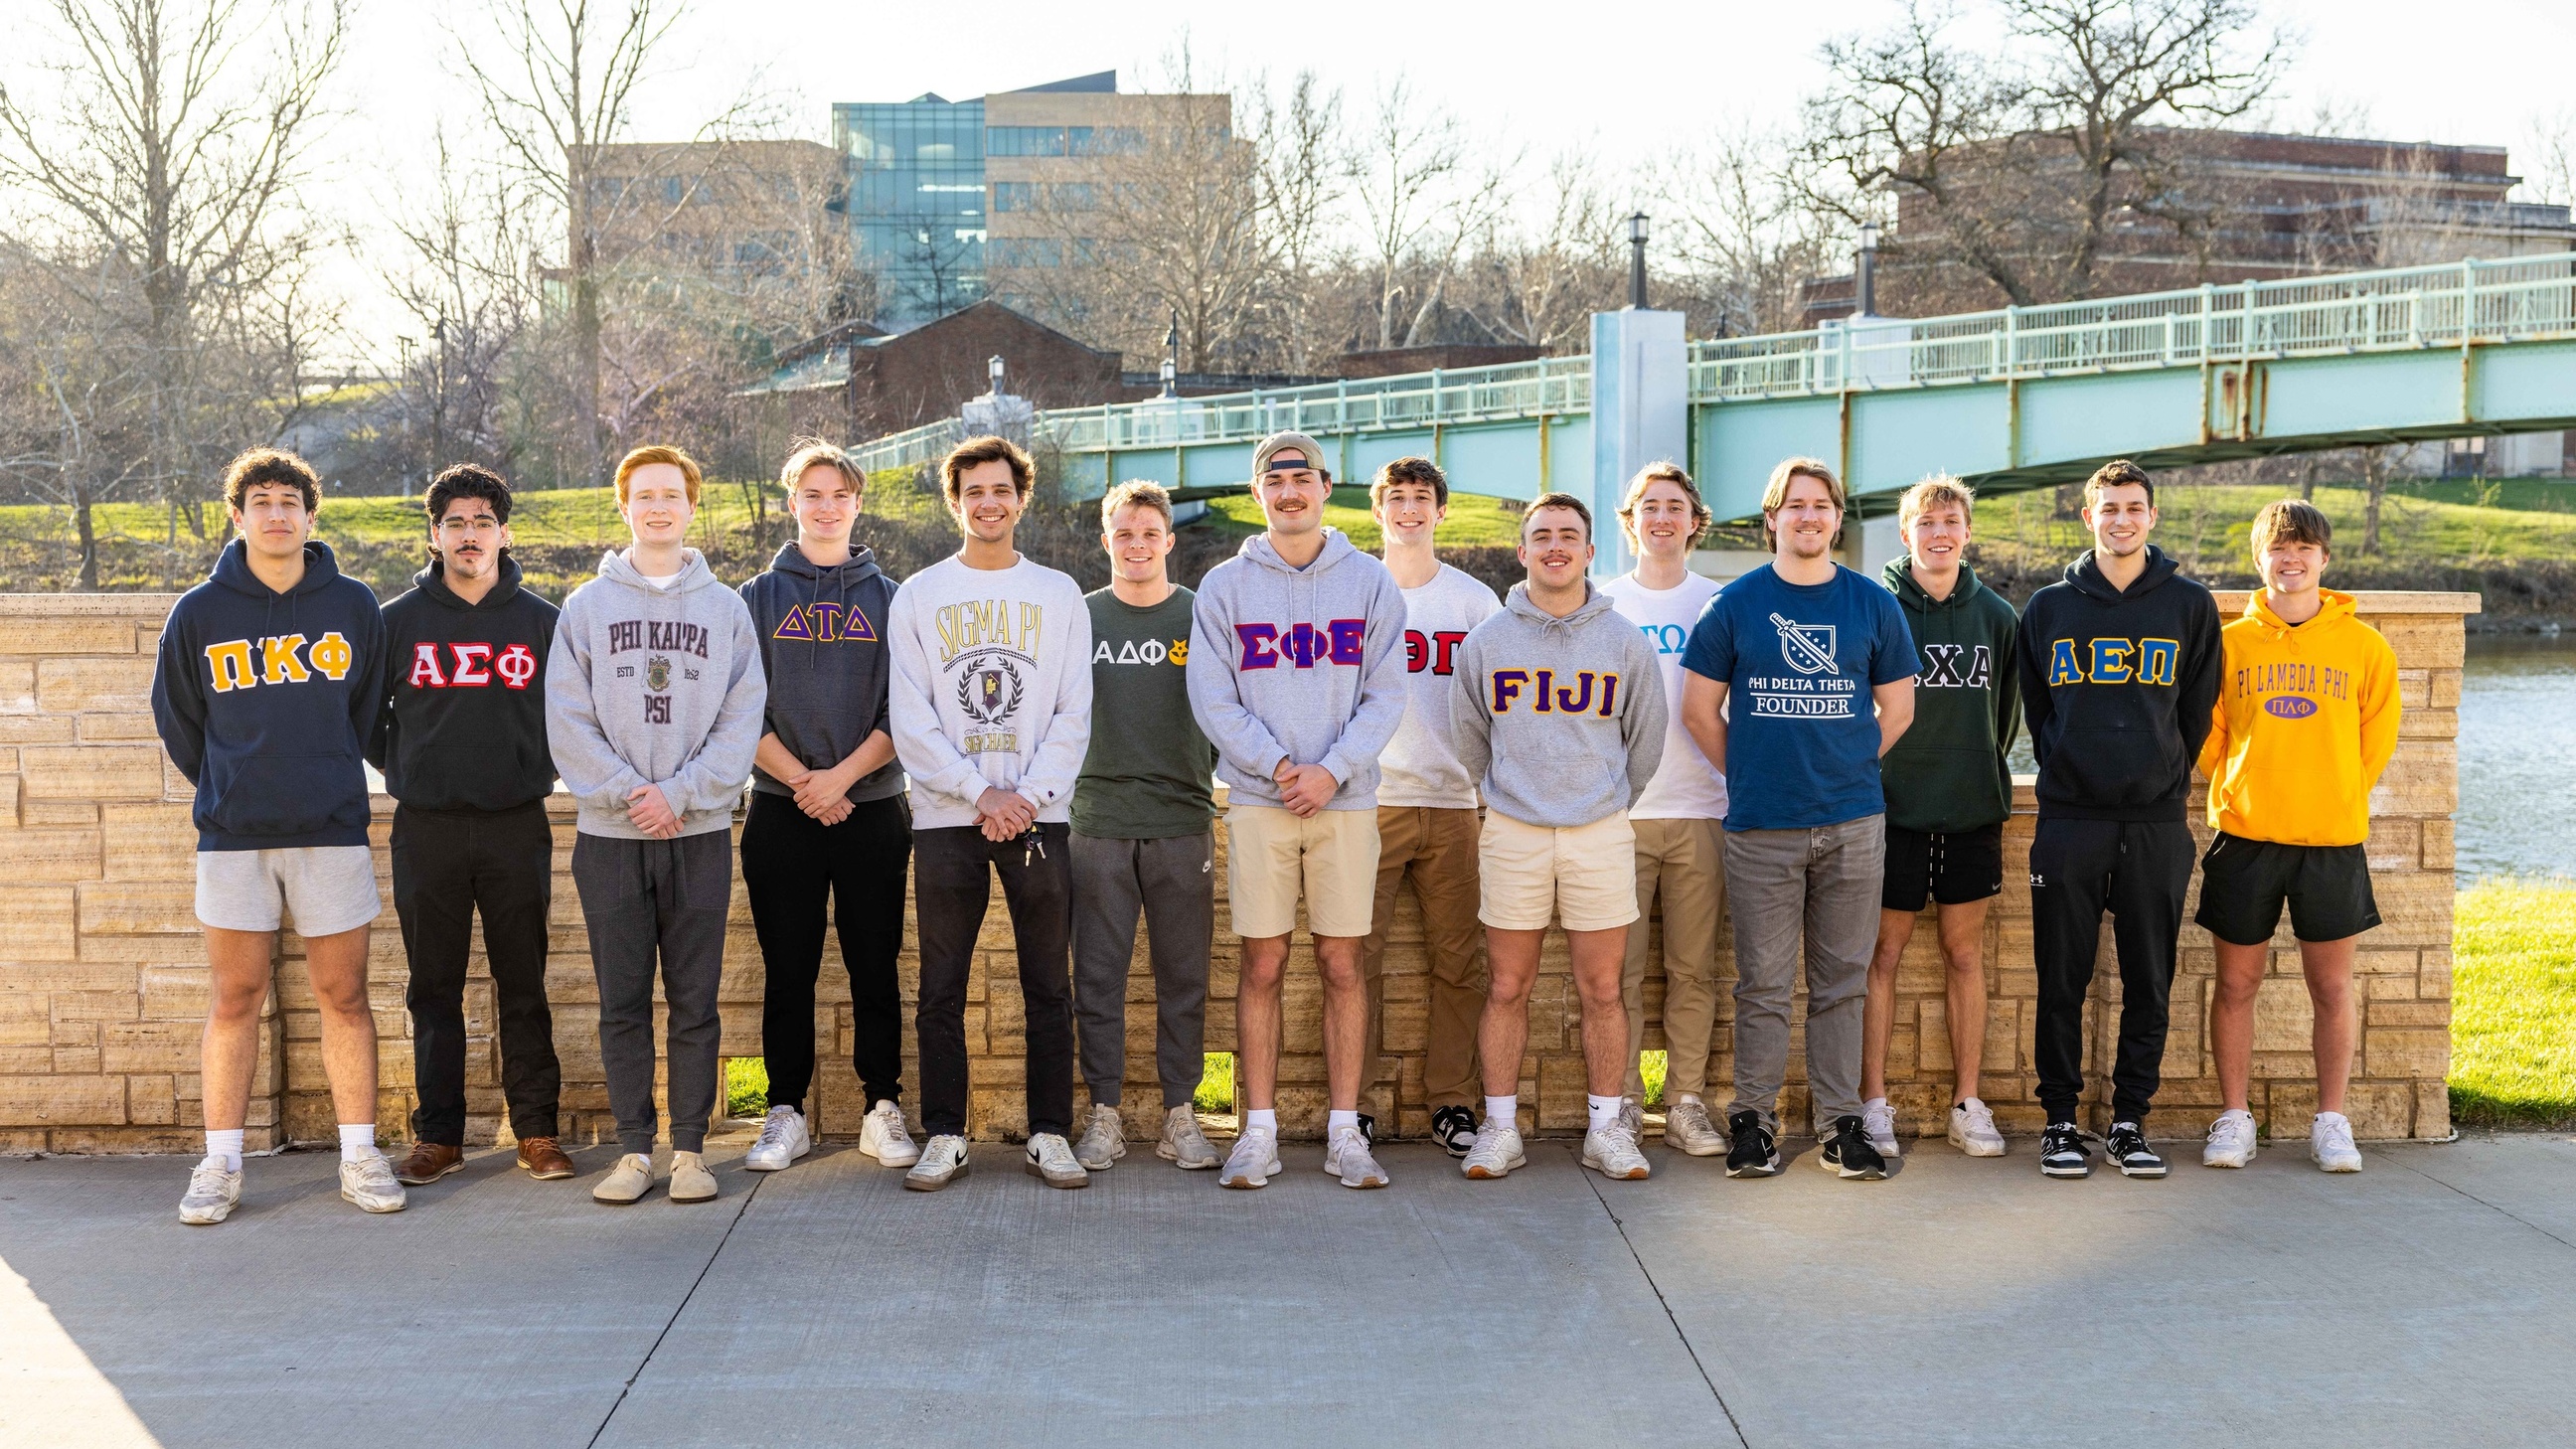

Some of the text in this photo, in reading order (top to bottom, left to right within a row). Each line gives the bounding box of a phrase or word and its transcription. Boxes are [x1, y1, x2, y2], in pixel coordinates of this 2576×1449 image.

[608, 620, 709, 660] PHI KAPPA
[935, 599, 1043, 663] SIGMA PI
[616, 666, 700, 681] ESTD 1852
[1748, 677, 1855, 691] PHI DELTA THETA
[2237, 663, 2348, 701] PI LAMBDA PHI
[643, 694, 672, 724] PSI
[1491, 667, 1621, 720] FIJI
[1755, 697, 1850, 715] FOUNDER
